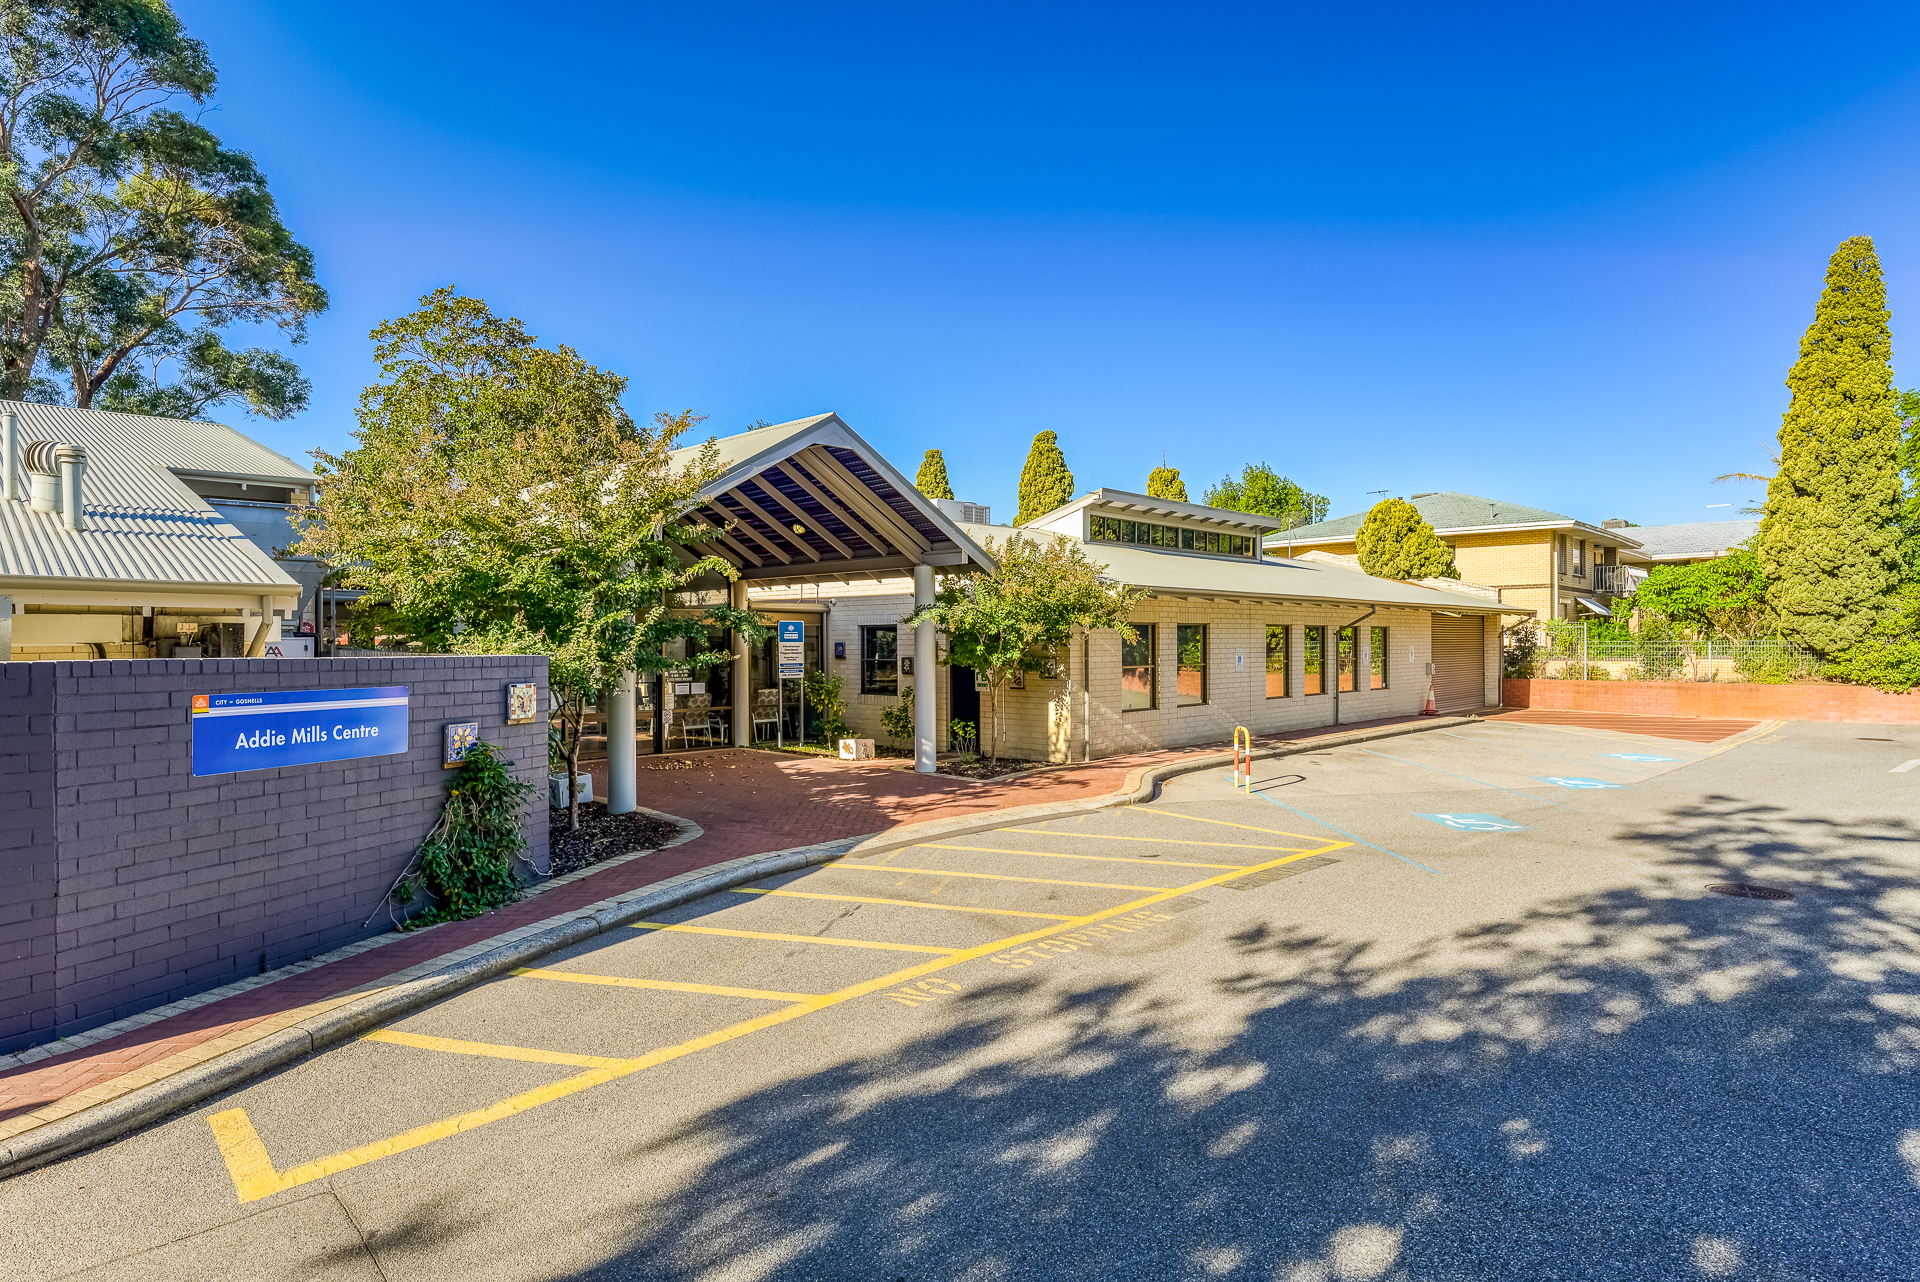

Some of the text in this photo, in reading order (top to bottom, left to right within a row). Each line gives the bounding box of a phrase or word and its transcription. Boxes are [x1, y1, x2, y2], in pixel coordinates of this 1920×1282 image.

[235, 697, 263, 705] GOSNELLS
[235, 724, 379, 750] Addie Mills Centre
[882, 911, 1175, 1008] NO STOPPING
